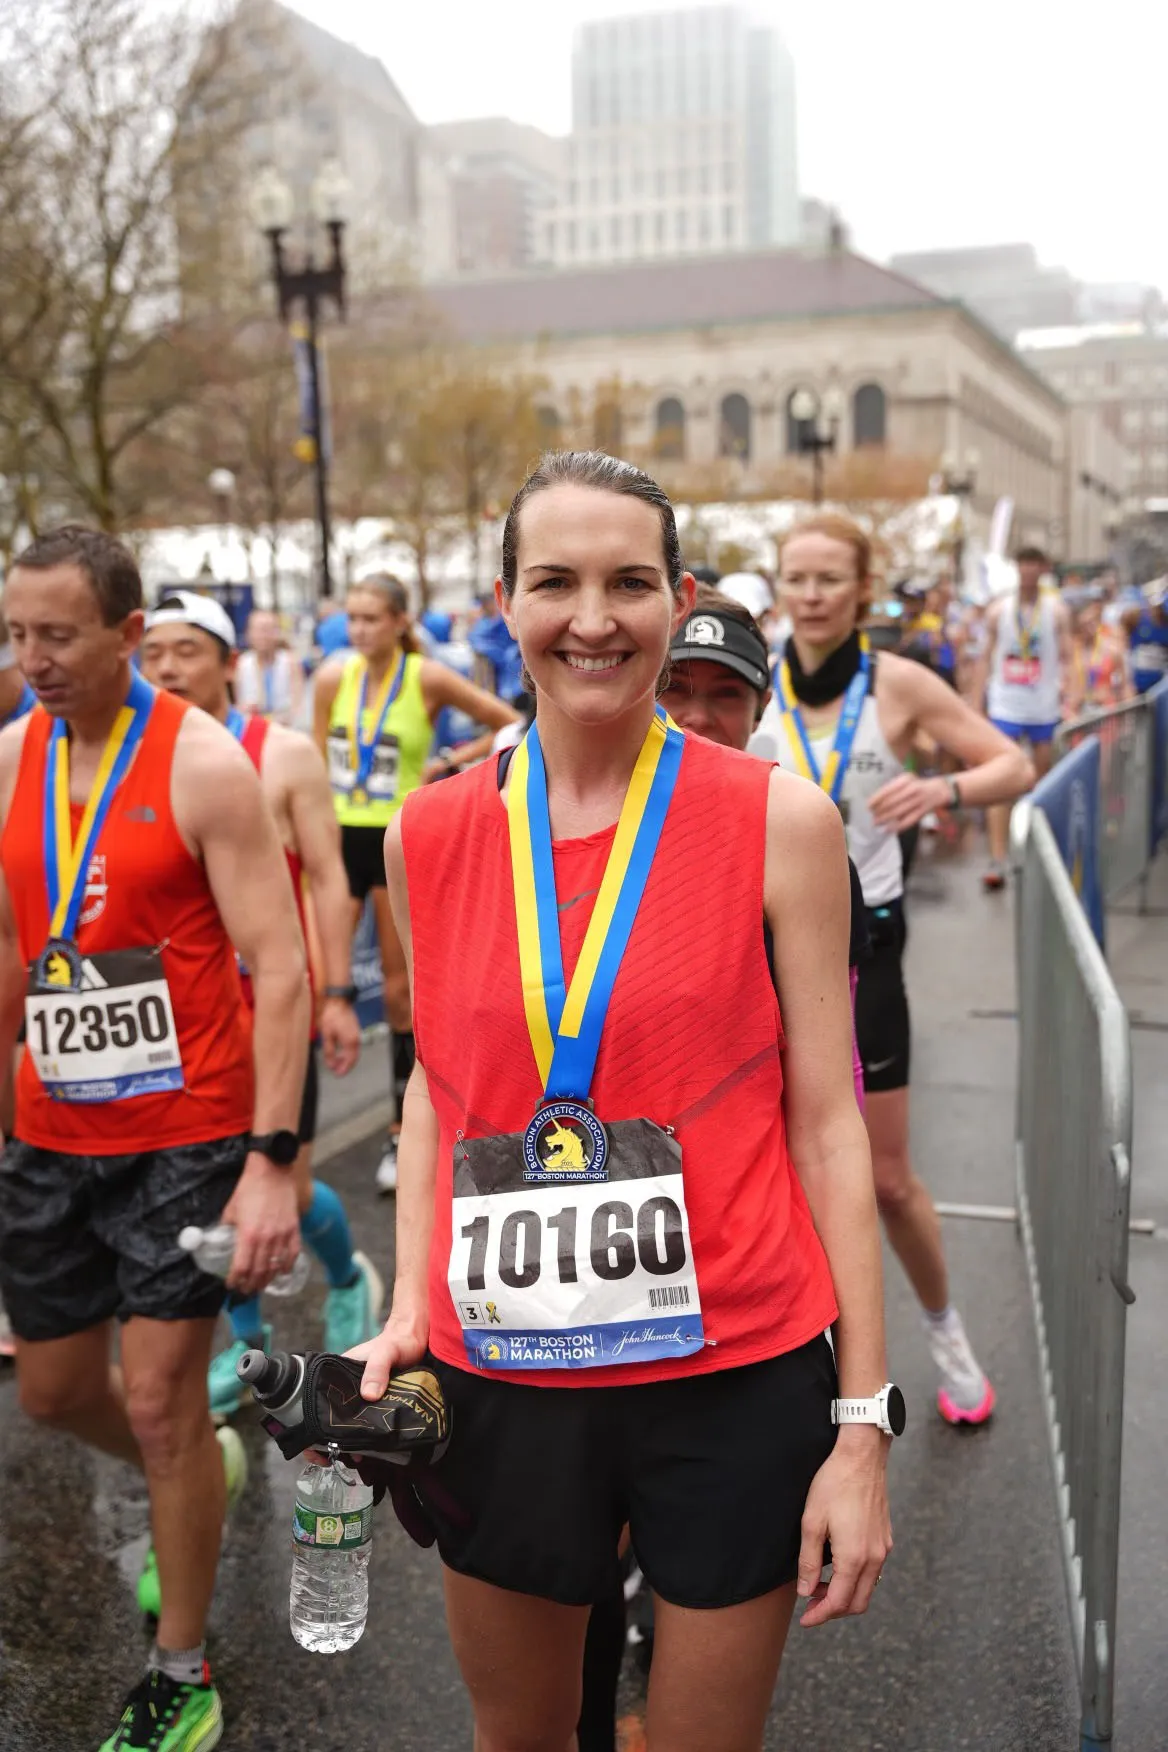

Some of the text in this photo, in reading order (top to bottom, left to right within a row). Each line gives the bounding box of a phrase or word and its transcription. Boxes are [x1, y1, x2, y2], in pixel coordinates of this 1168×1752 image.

[34, 995, 169, 1055] 12350
[526, 1106, 604, 1170] BOSTON ATHLETIC ASSOCIATION
[461, 1196, 686, 1290] 10160
[466, 1307, 478, 1320] 3
[509, 1336, 537, 1348] 127TH
[539, 1333, 594, 1347] BOSTON
[510, 1346, 596, 1360] MARATHON
[612, 1326, 686, 1356] John Hancock
